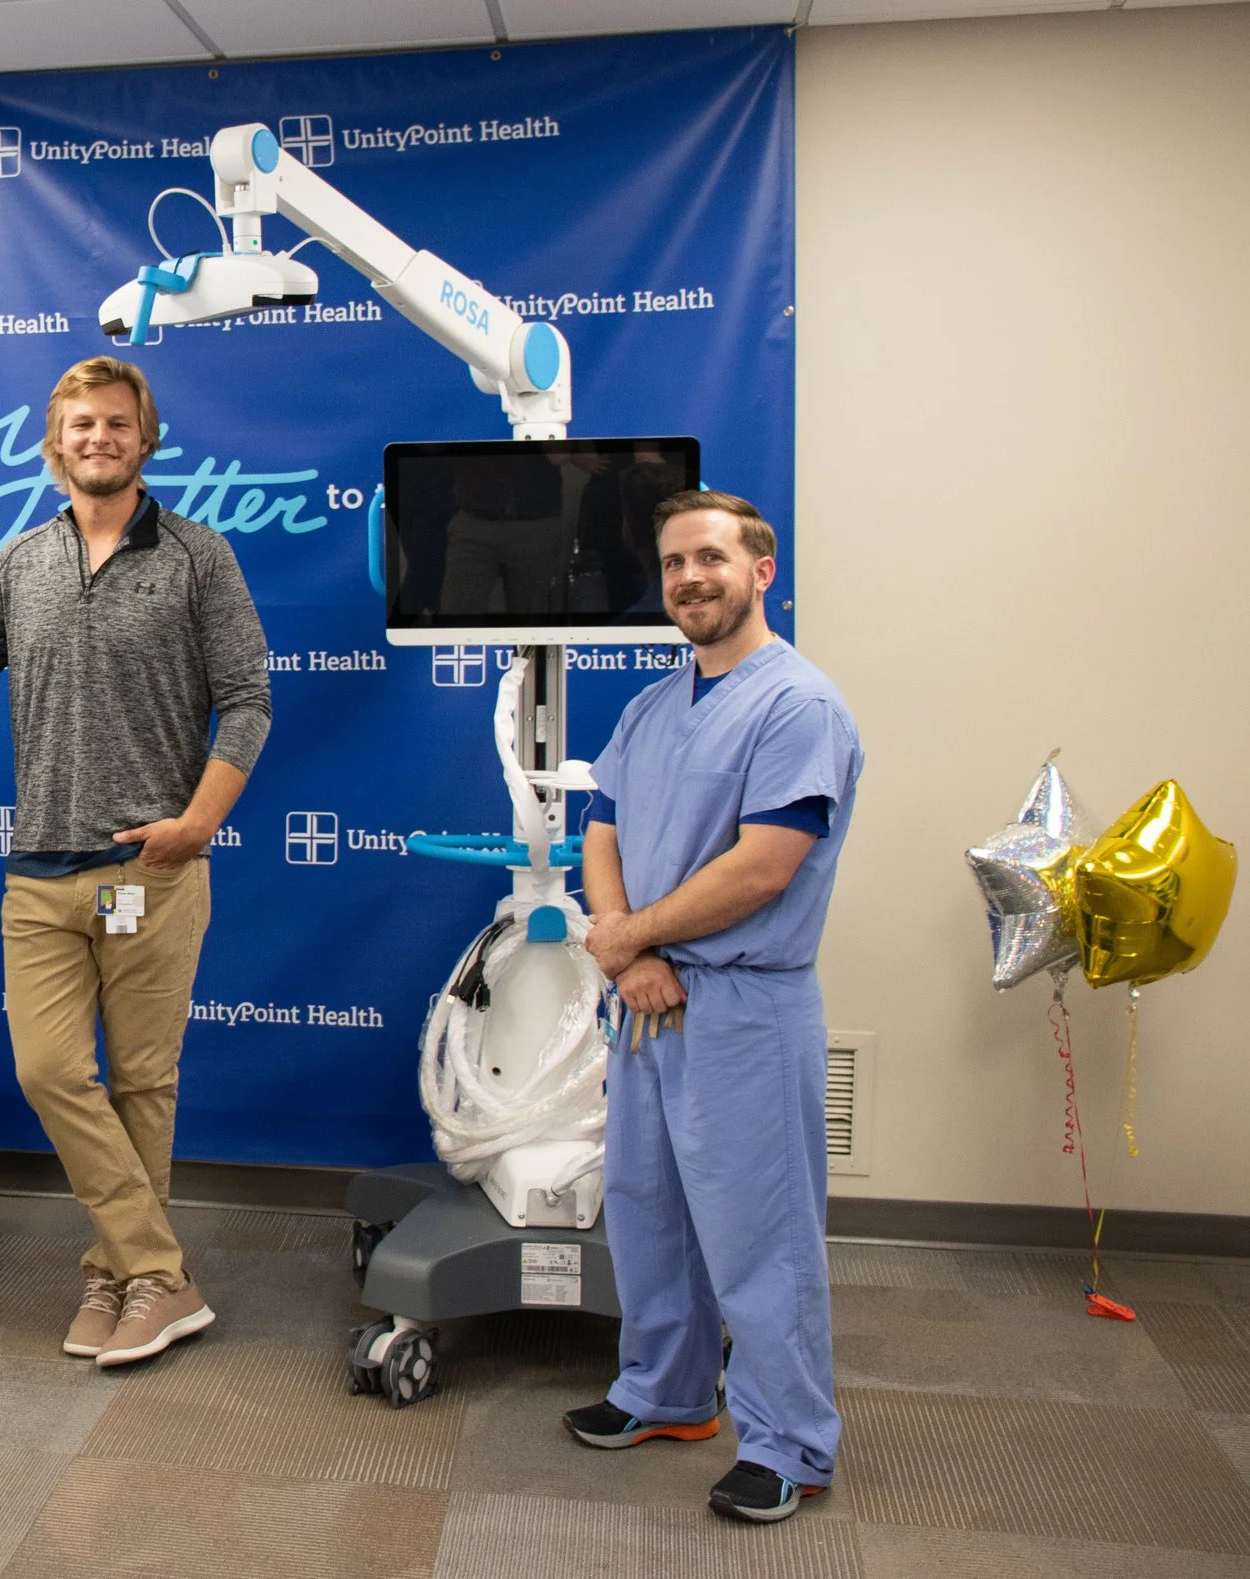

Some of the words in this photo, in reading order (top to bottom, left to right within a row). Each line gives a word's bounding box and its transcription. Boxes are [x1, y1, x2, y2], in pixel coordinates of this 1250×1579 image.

[342, 123, 472, 151] UnityPoint
[479, 116, 561, 142] Health
[30, 139, 154, 164] UnityPoint
[160, 136, 210, 158] Heal
[440, 280, 490, 336] ROSA
[632, 287, 715, 312] Health
[303, 301, 382, 324] Health
[326, 484, 364, 510] to
[308, 650, 387, 671] Health
[307, 1005, 384, 1027] Health
